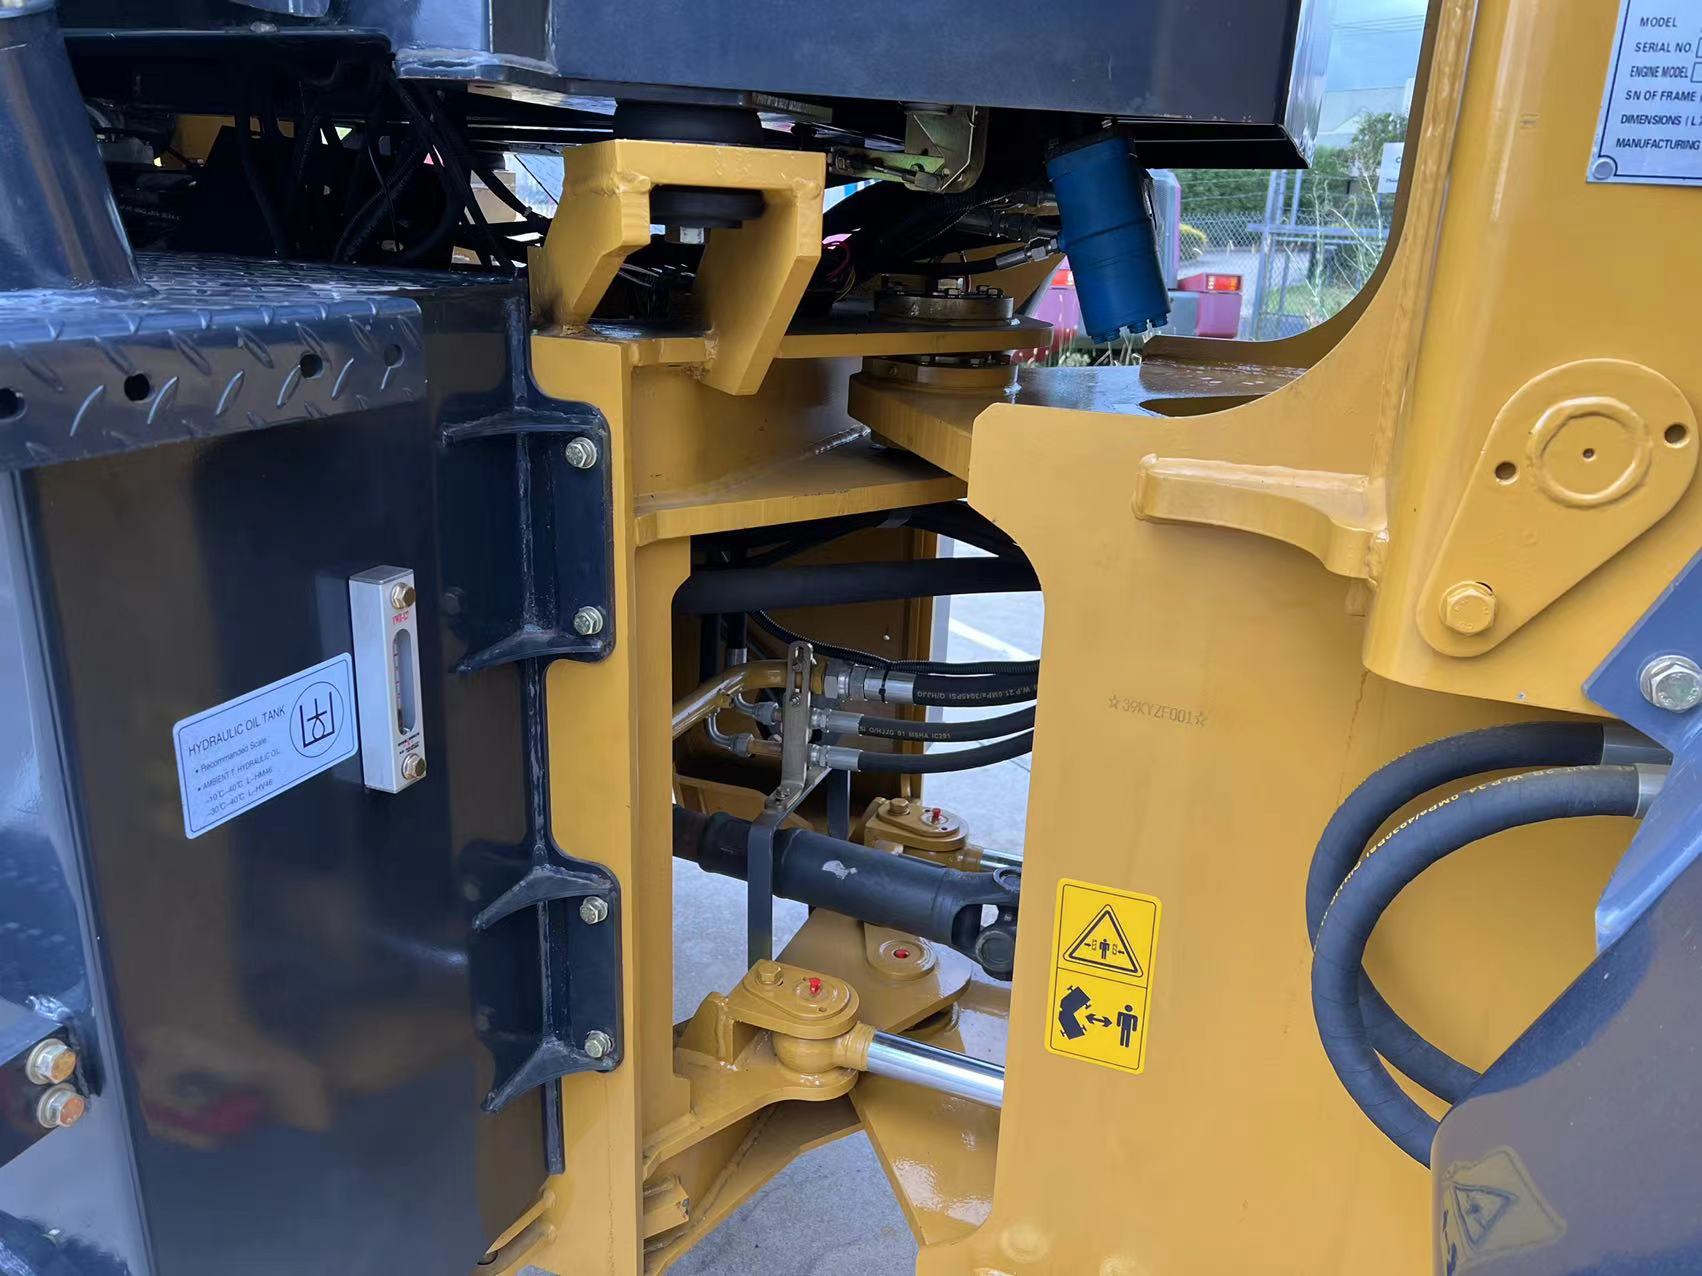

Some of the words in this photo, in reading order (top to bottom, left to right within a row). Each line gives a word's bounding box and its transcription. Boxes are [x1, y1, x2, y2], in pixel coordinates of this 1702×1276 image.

[1640, 16, 1678, 28] MODEL
[1634, 42, 1672, 53] SERIAL
[1630, 65, 1659, 78] ENGINE
[1661, 66, 1688, 78] MODEL
[1625, 90, 1641, 101] SN
[1644, 90, 1658, 101] OF
[1659, 91, 1696, 102] FRAME
[1620, 114, 1682, 126] DIMENSIONS
[1616, 138, 1700, 150] MANUFACTURING
[188, 723, 244, 757] HYDRAULIC
[246, 718, 261, 732] OIL
[263, 704, 287, 724] TANK
[203, 772, 231, 790] AMBIENT
[237, 753, 271, 775] HYDRAULIC
